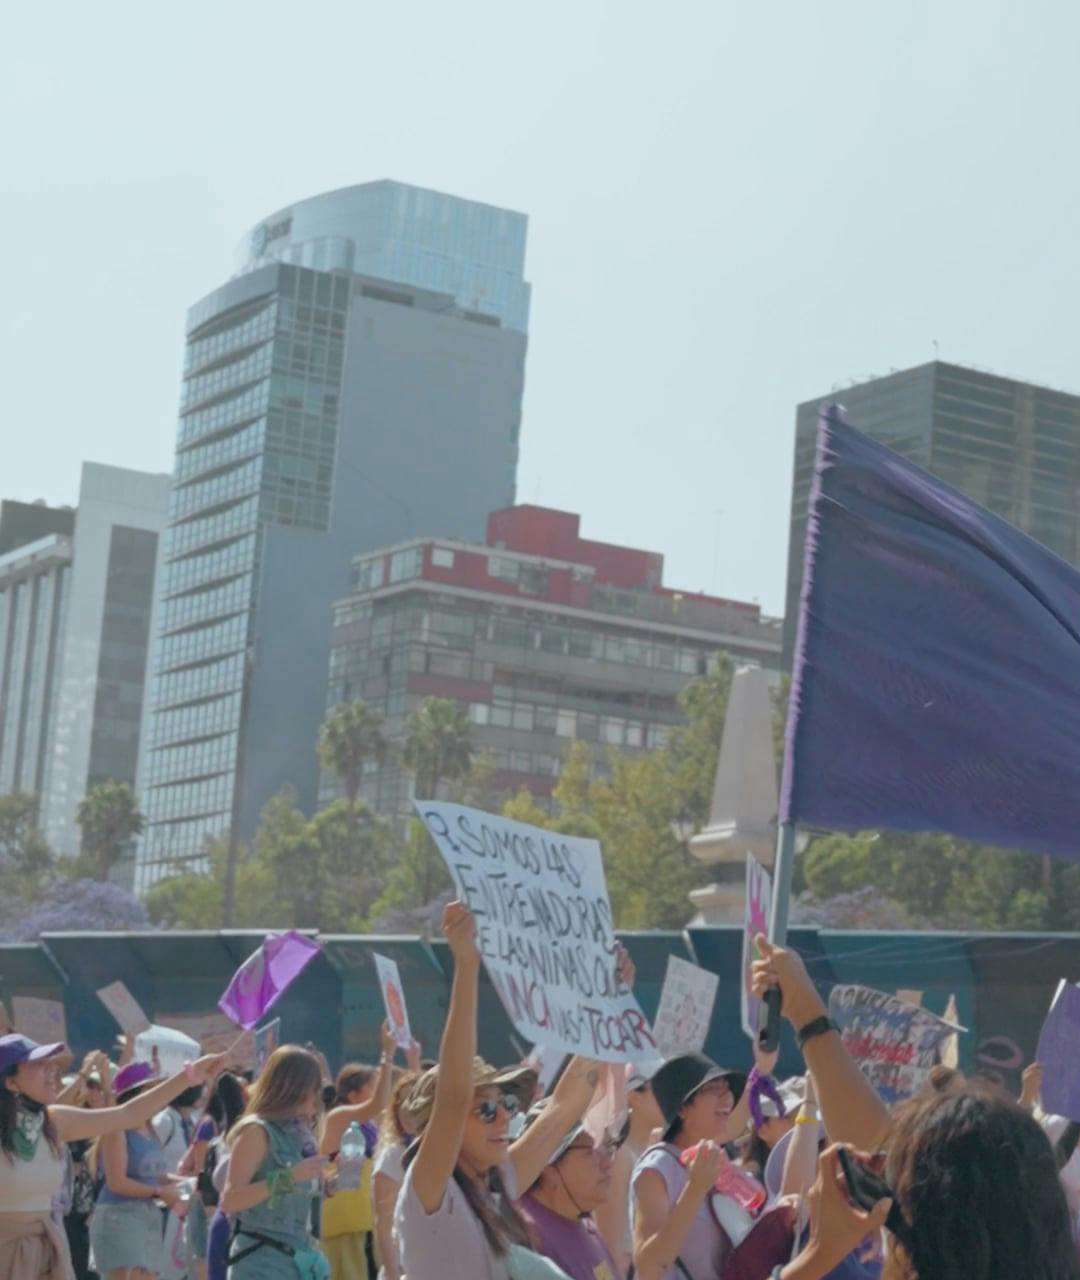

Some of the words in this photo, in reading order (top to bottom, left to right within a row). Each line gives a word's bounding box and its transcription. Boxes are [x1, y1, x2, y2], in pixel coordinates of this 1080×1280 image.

[457, 815, 541, 876] SOMOS
[540, 837, 582, 889] LAS
[455, 863, 618, 955] ENTRENADORAS
[497, 929, 530, 969] LAS
[504, 972, 551, 1030] NO
[582, 1005, 657, 1055] TOCAR
